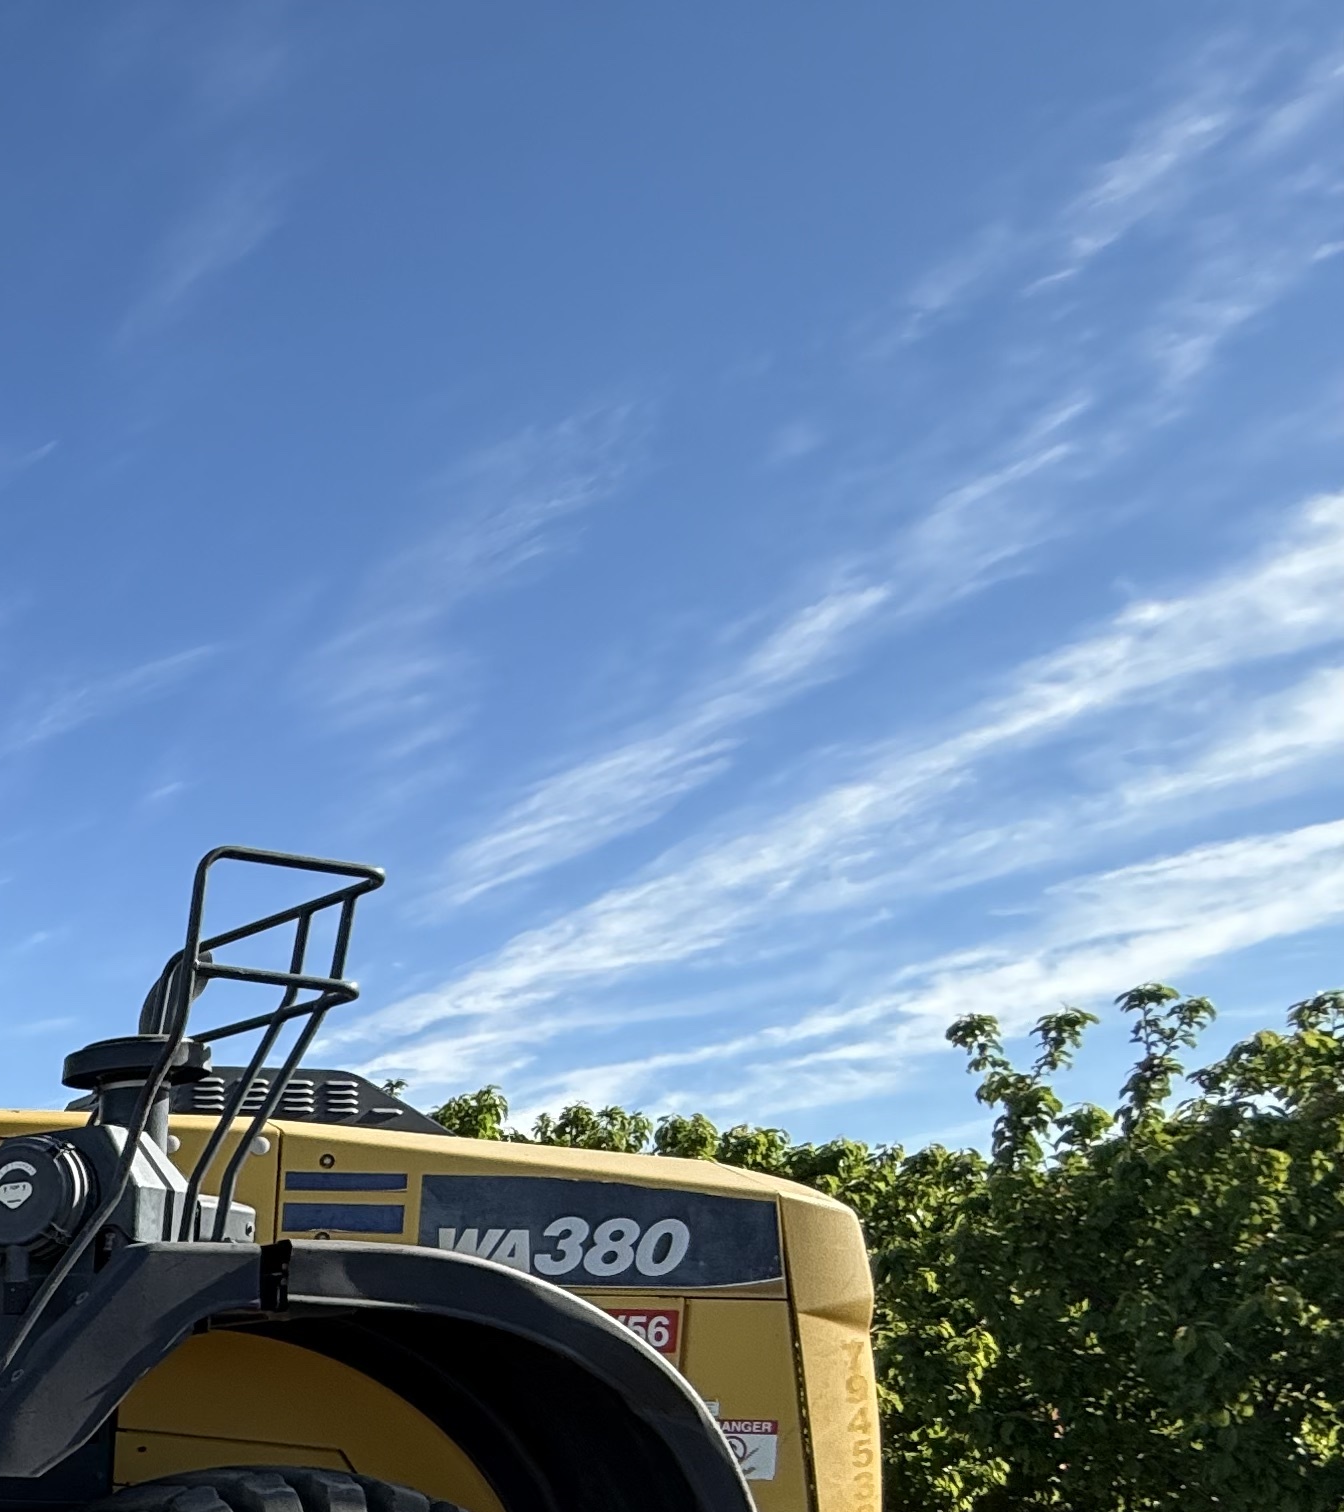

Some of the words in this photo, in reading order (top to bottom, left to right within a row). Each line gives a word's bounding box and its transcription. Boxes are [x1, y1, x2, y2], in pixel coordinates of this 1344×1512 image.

[438, 1216, 690, 1276] WA380
[618, 1315, 670, 1347] 56
[716, 1421, 772, 1432] ANGER
